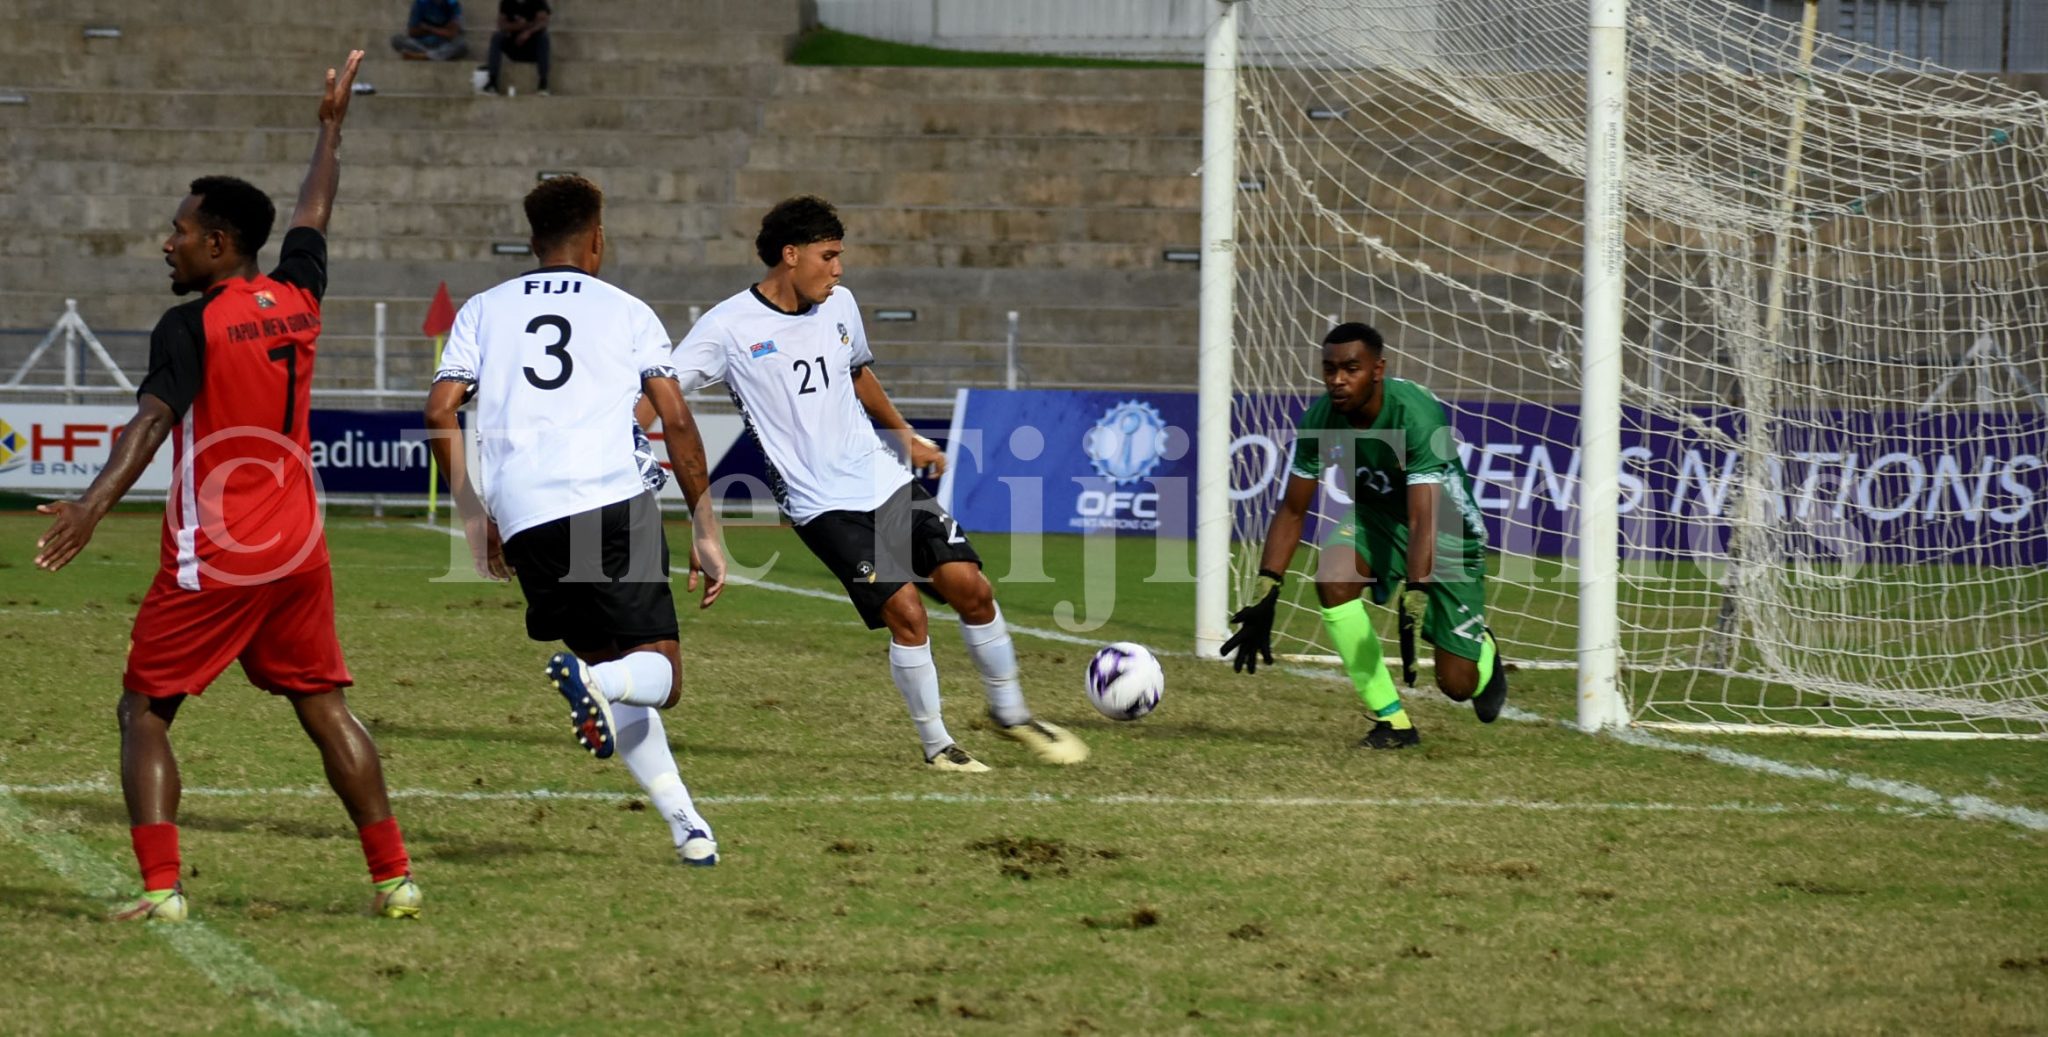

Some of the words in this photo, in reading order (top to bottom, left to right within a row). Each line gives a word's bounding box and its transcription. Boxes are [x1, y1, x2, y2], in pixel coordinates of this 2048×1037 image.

[524, 281, 582, 295] FIJI
[227, 321, 259, 344] PAPUA
[261, 318, 289, 338] NEW
[523, 314, 573, 390] 3
[267, 343, 297, 434] 7
[793, 355, 829, 395] 21
[1076, 490, 1160, 518] OFC
